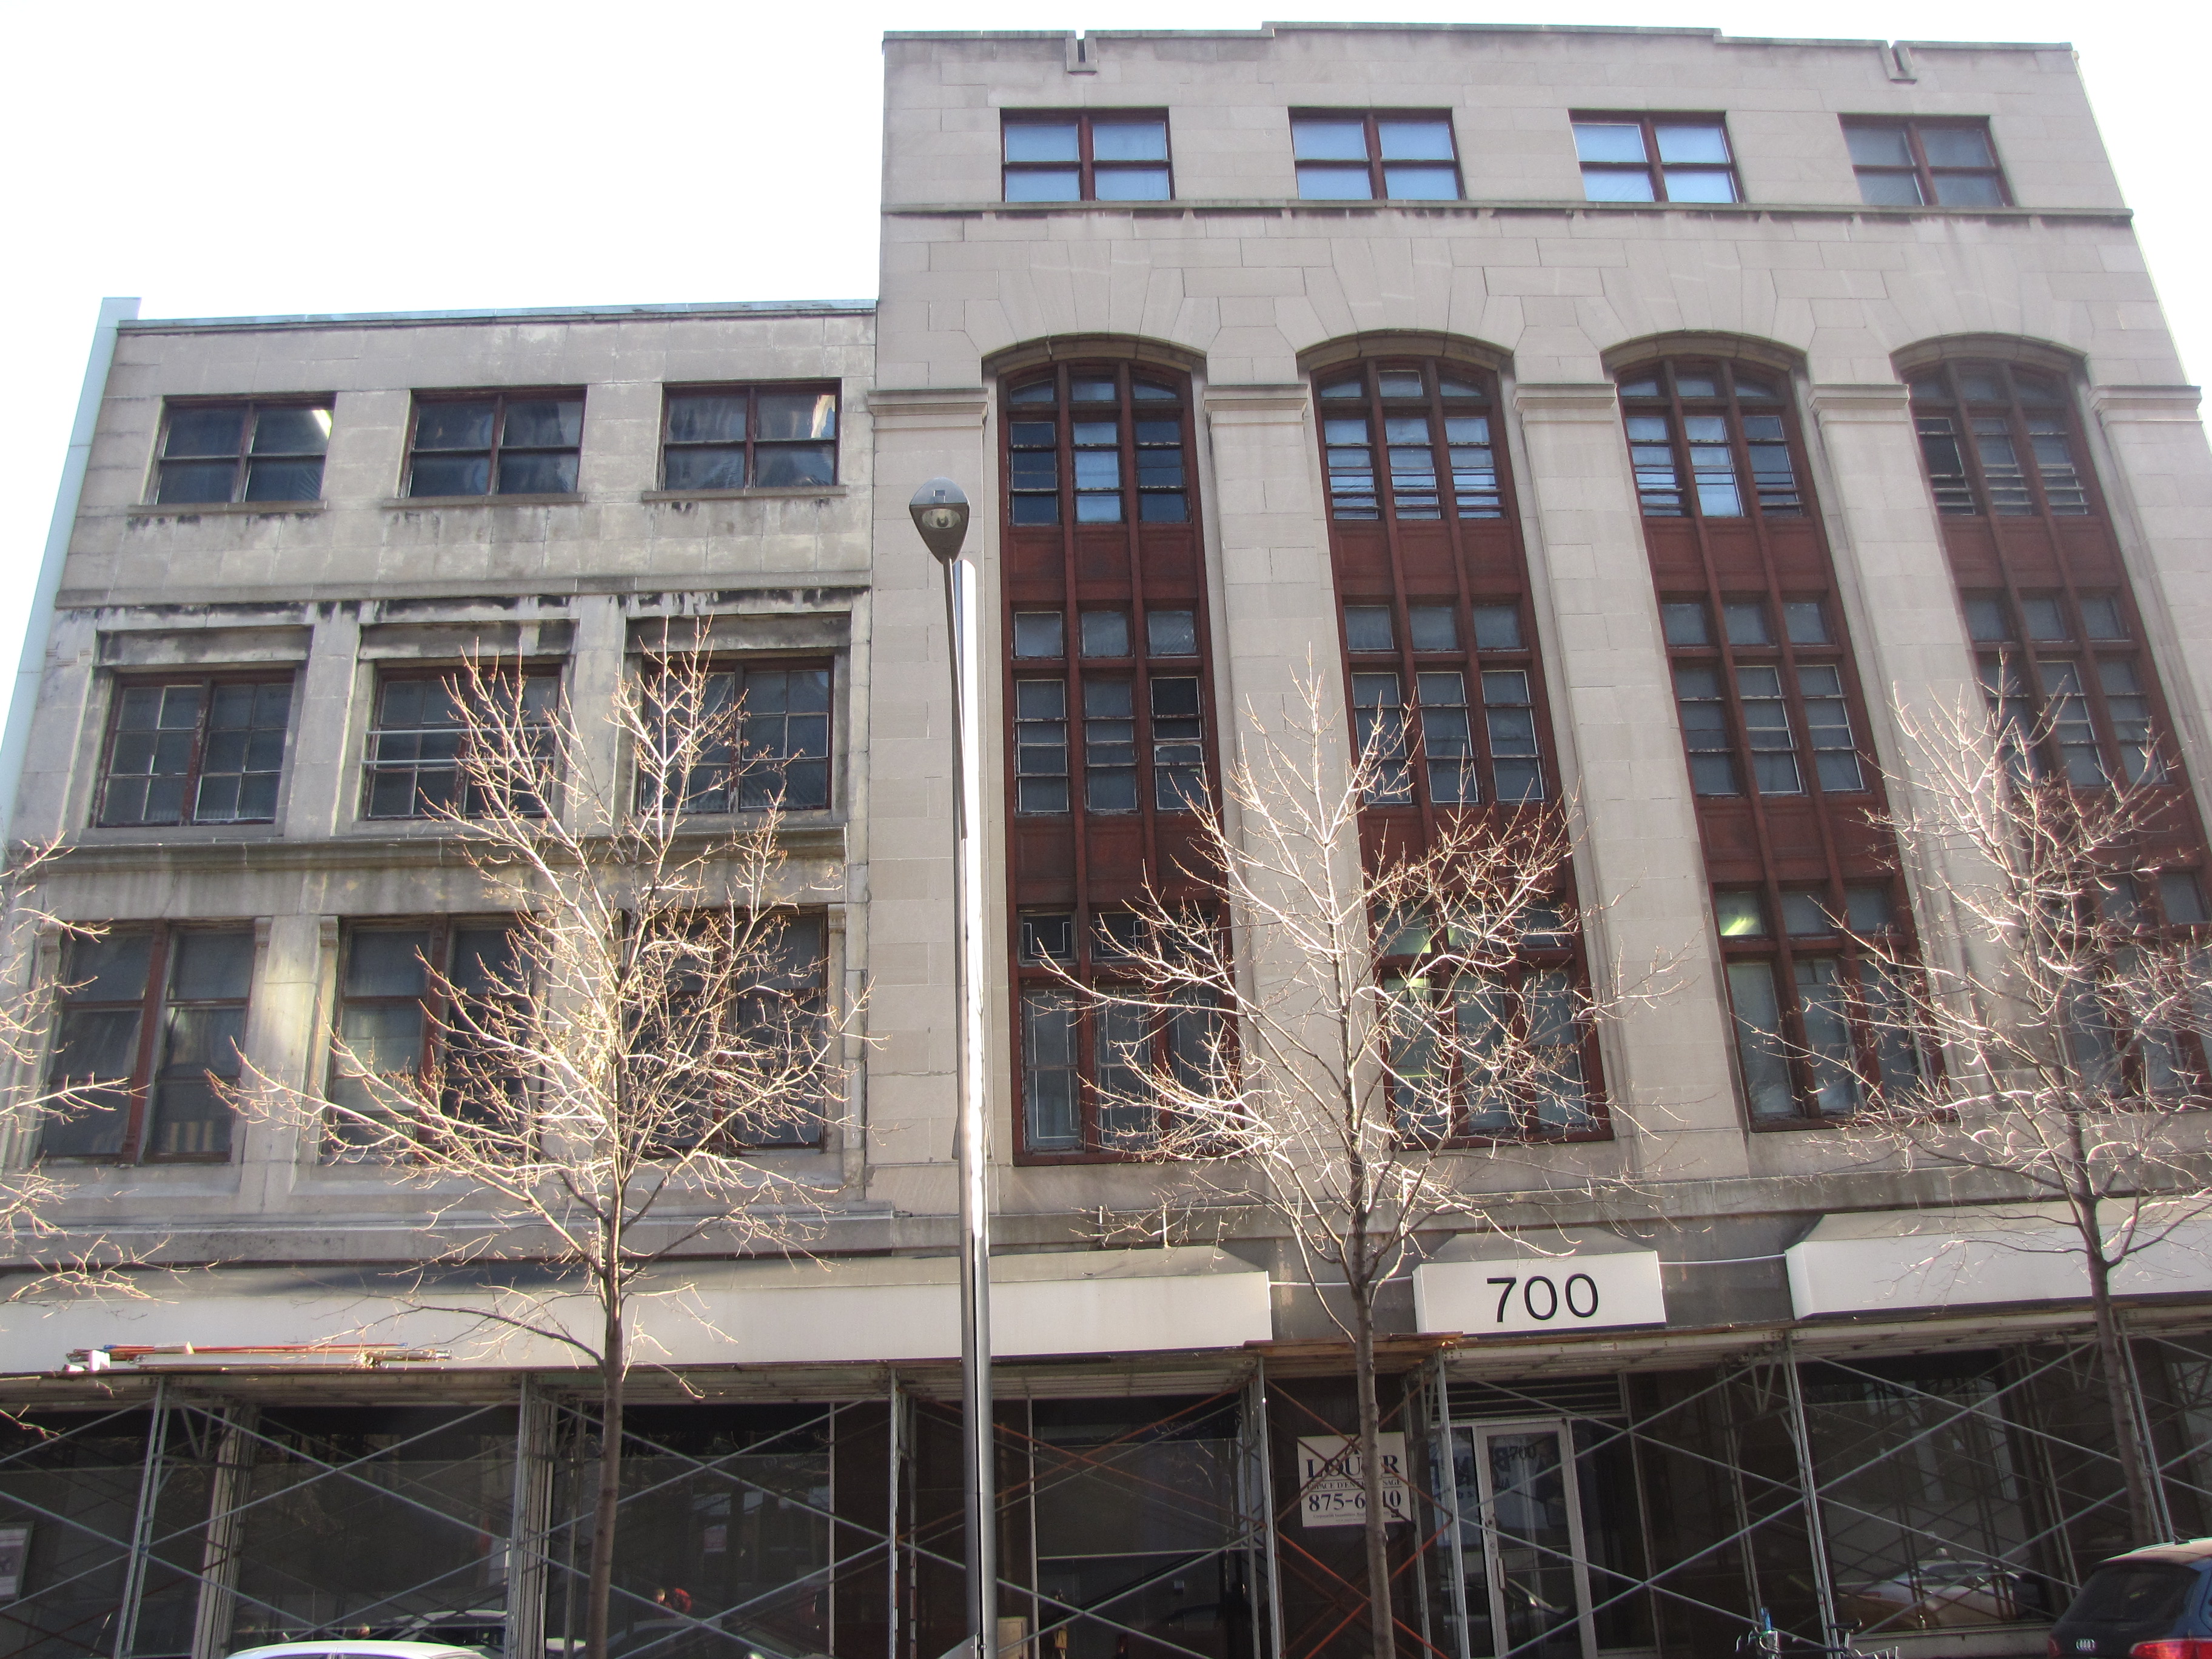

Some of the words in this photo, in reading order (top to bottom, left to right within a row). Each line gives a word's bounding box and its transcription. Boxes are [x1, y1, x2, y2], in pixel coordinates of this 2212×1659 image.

[1486, 1273, 1599, 1322] 700
[1509, 1444, 1537, 1460] 700
[1305, 1455, 1400, 1478] LOUR
[1309, 1490, 1401, 1512] 875-610
